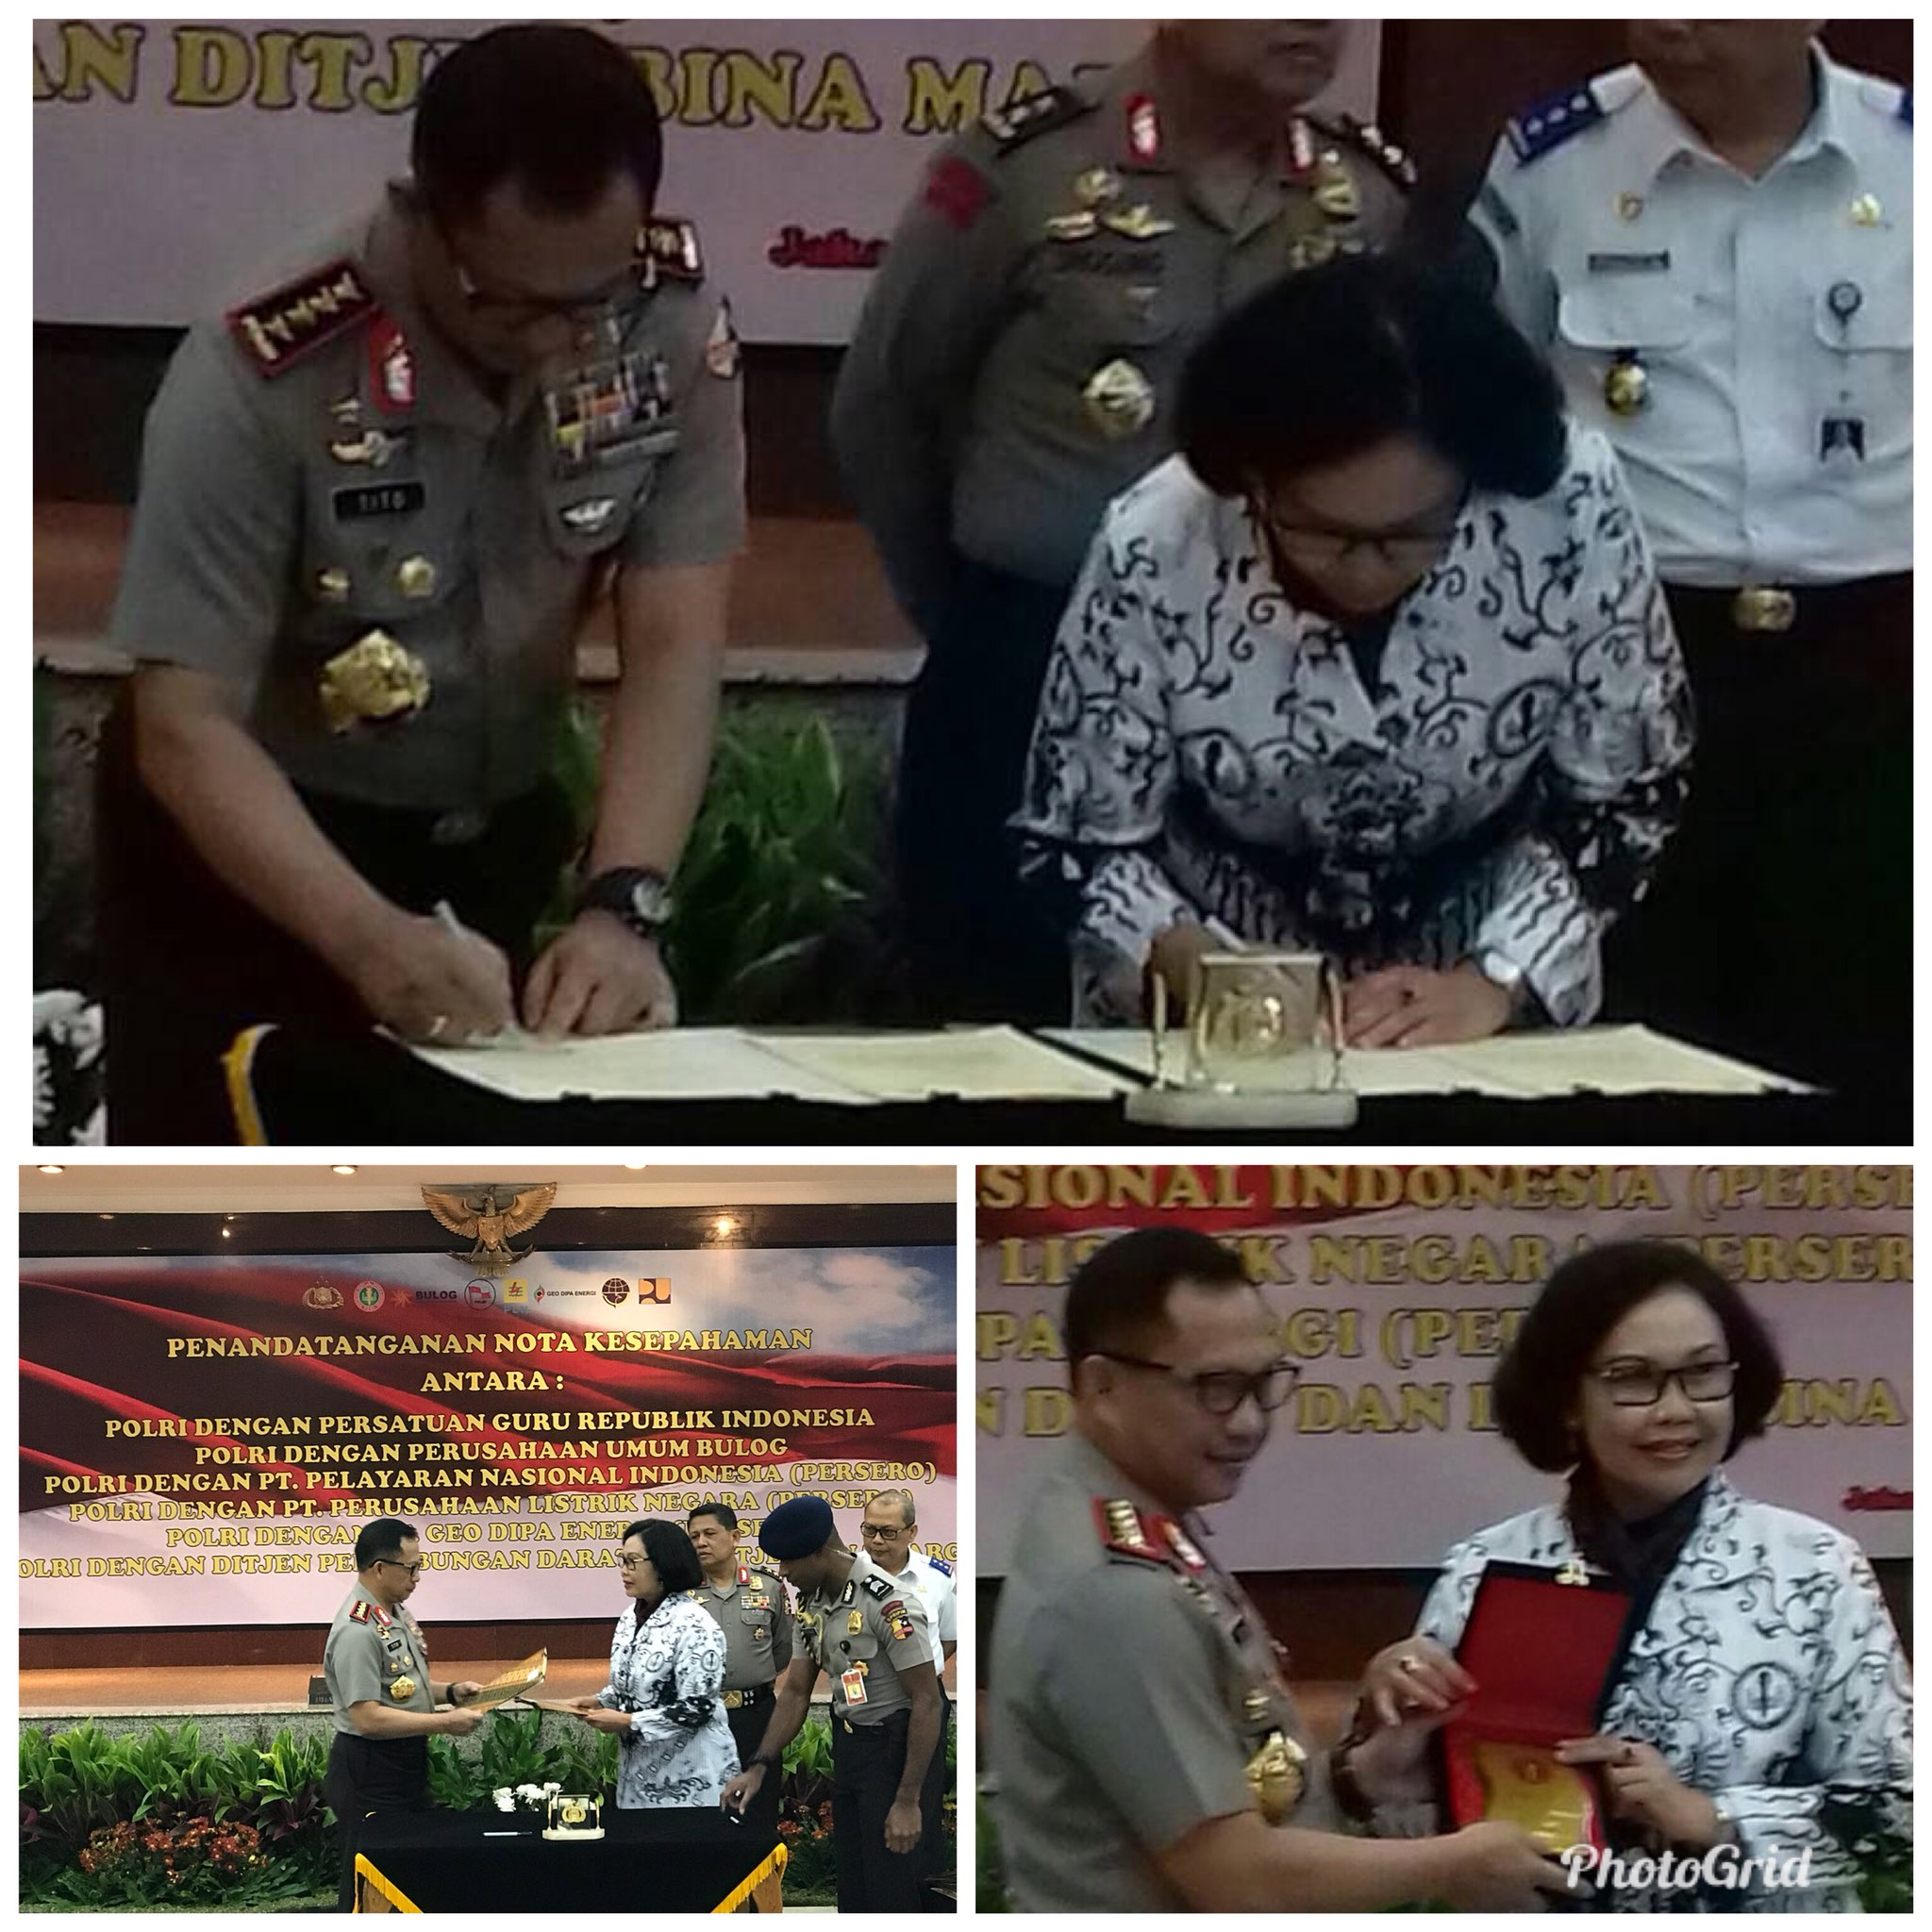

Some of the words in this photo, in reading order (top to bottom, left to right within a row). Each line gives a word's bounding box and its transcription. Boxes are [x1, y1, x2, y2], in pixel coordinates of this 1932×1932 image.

[169, 25, 464, 115] DITJ
[975, 1165, 1256, 1209] SIONAL
[1271, 1165, 1673, 1210] INDONESIA
[1307, 1233, 1594, 1285] NEGAR
[415, 1290, 458, 1301] BULOG
[167, 1333, 487, 1358] PENANDATANGANAN
[493, 1331, 578, 1353] NOTA
[583, 1327, 813, 1352] KESEPAHAMAN
[420, 1371, 550, 1392] ANTARA
[105, 1418, 188, 1438] POLRI
[194, 1416, 311, 1437] DENGAN
[318, 1413, 485, 1435] PERSATUAN
[491, 1411, 571, 1432] GURU
[577, 1409, 716, 1430] REPUBLIK
[721, 1407, 875, 1428] INDONESIA
[1295, 1383, 1452, 1434] DAN
[194, 1445, 278, 1466] POLRI
[283, 1442, 401, 1464] DENGAN
[408, 1440, 599, 1461] PERUSAHAAN
[606, 1438, 690, 1458] UMUM
[695, 1438, 789, 1457] BULOG
[44, 1474, 128, 1494] POLRI
[134, 1472, 252, 1493] DENGAN
[258, 1471, 299, 1491] PT.
[305, 1468, 475, 1490] PELAYARAN
[480, 1464, 624, 1488] NASIONAL
[628, 1463, 783, 1485] INDONESIA
[789, 1460, 937, 1486] (PERSERO)
[68, 1501, 154, 1523] POLRI
[158, 1499, 275, 1522] DENGAN
[282, 1498, 324, 1518] PT.
[329, 1495, 521, 1517] PERUSAHAAN
[527, 1493, 638, 1514] LISTRIK
[642, 1491, 760, 1513] NEGARA
[166, 1526, 251, 1548] POLRI
[254, 1524, 364, 1546] DENGA
[425, 1523, 483, 1543] GEO
[489, 1522, 555, 1542] DIPA
[86, 1555, 206, 1577] DENGAN
[211, 1554, 311, 1575] DITJEN
